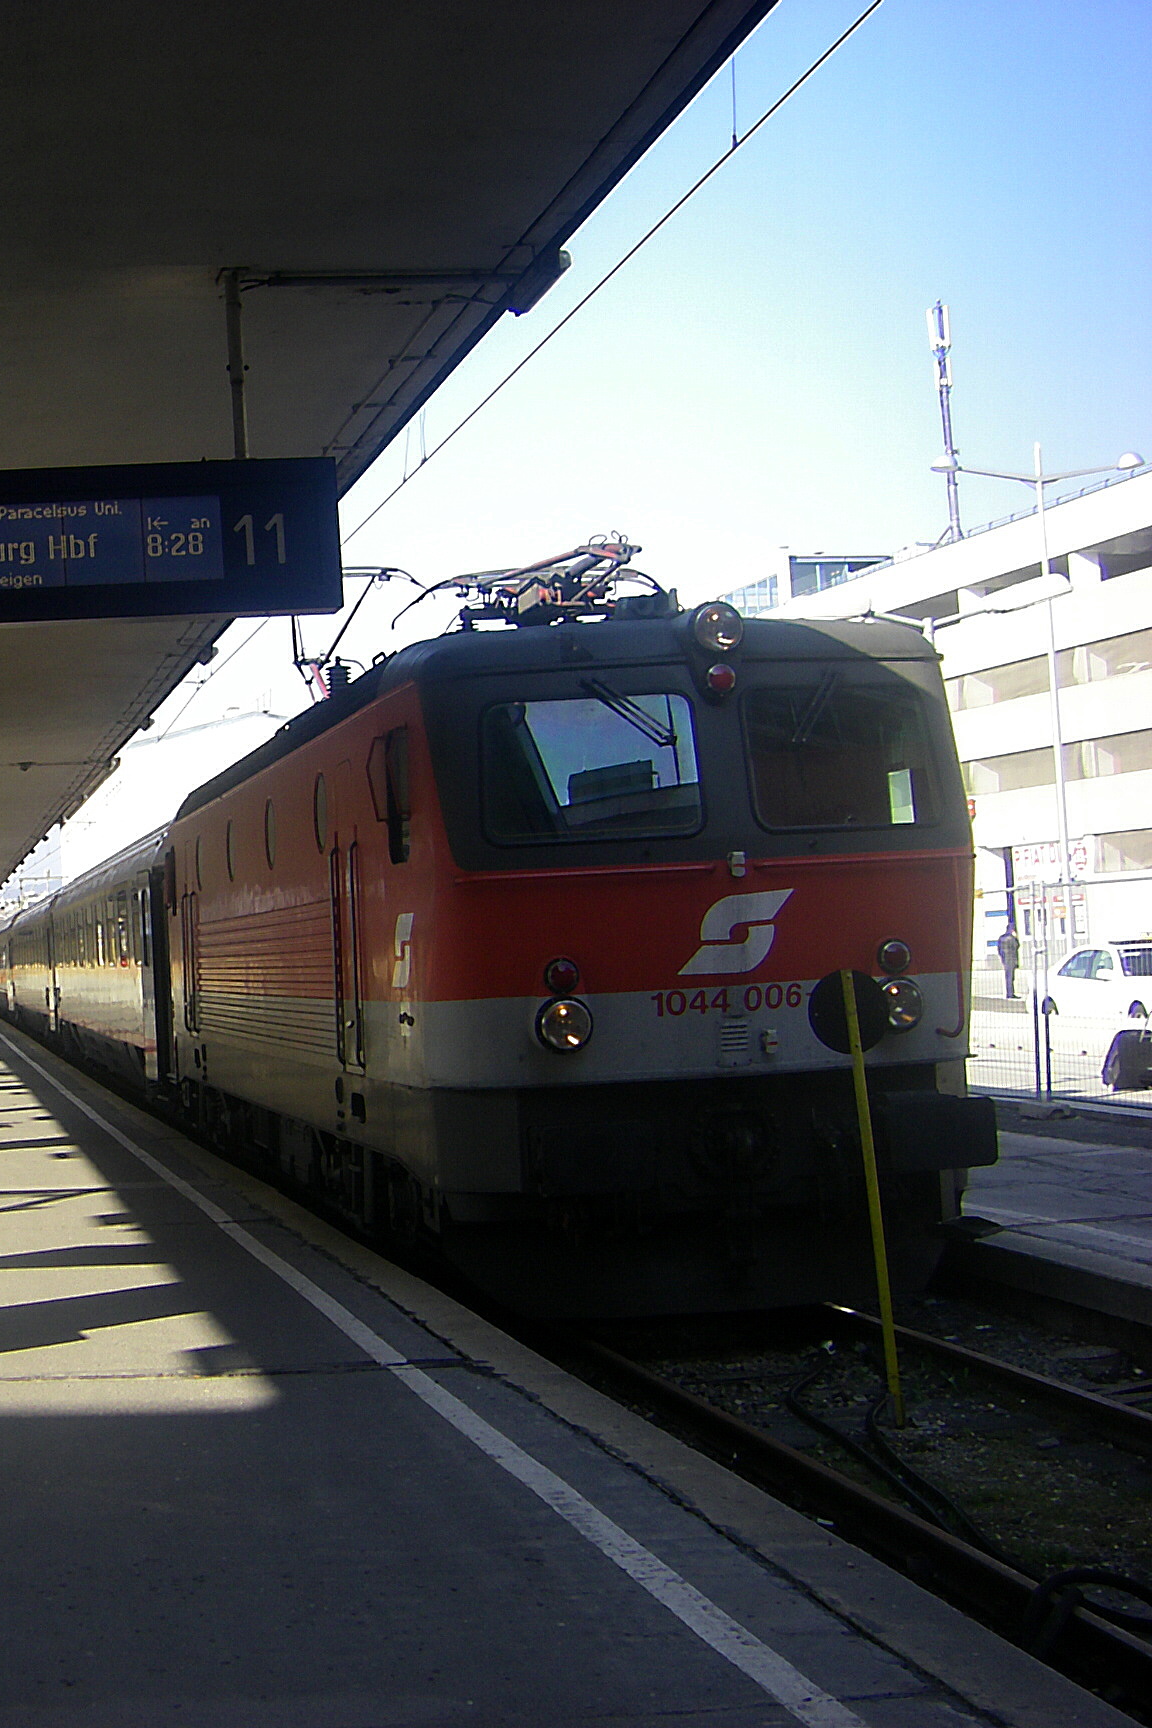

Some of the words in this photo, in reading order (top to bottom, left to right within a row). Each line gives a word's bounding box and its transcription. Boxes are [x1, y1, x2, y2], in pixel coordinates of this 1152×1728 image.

[94, 501, 123, 516] Uni.
[190, 517, 211, 530] an
[48, 532, 99, 561] Hbf
[147, 531, 204, 558] 8:28
[232, 512, 287, 566] 11
[650, 988, 731, 1017] 1044
